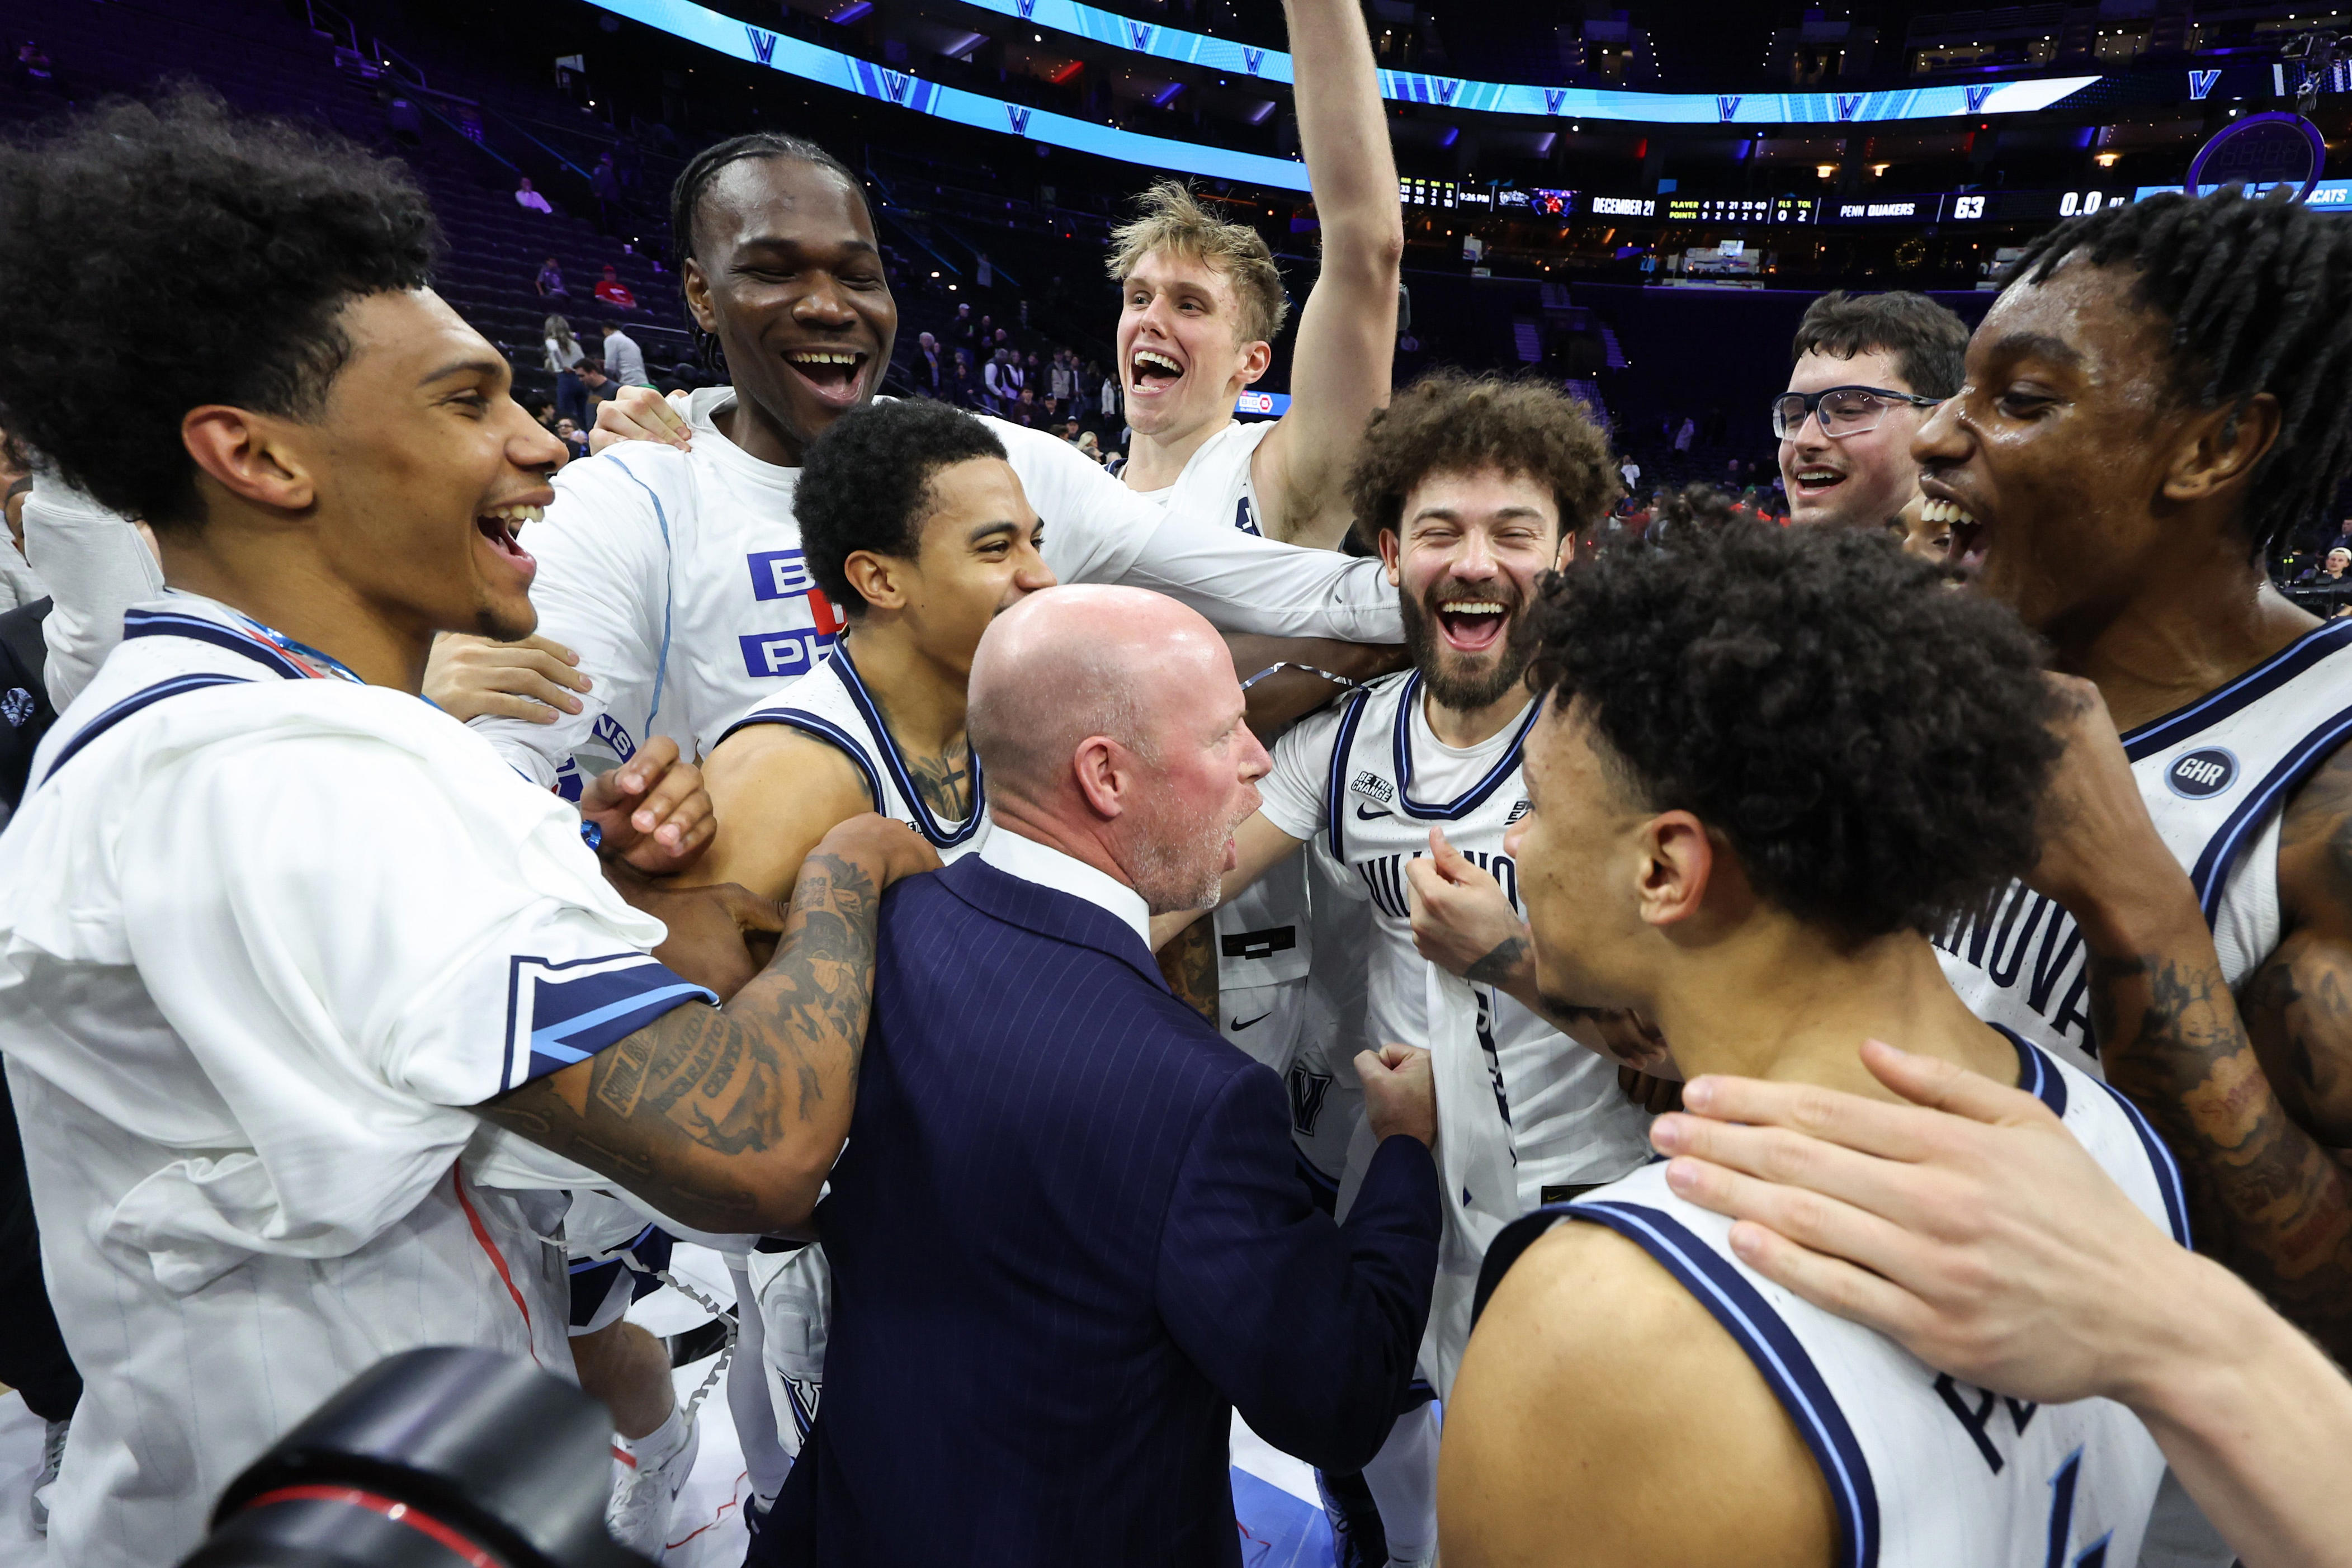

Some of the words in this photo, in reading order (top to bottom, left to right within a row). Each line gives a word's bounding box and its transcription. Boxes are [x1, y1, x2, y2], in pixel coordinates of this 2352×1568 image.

[1432, 188, 1437, 197] 2
[1460, 192, 1476, 202] 9:26
[1477, 194, 1490, 203] PM
[1414, 196, 1424, 204] 20
[1430, 197, 1437, 206] 3
[1443, 199, 1453, 207] 10
[1593, 197, 1642, 215] DECEMBER
[1643, 200, 1655, 216] 21
[1716, 201, 1725, 210] 11
[1728, 201, 1739, 210] 21
[1741, 201, 1753, 210] 33
[1754, 201, 1767, 210] 40
[1954, 196, 1985, 219] 63
[1715, 212, 1721, 220] 2
[1728, 212, 1735, 220] 0
[1742, 212, 1749, 220] 2
[1777, 210, 1788, 221] 0
[1797, 210, 1807, 221] 2
[1840, 205, 1865, 217] PENN
[1867, 203, 1915, 216] QUAKERS
[2176, 758, 2226, 786] GHR
[1358, 771, 1374, 783] BE
[1373, 777, 1393, 792] THE
[1352, 780, 1391, 802] CHANGE
